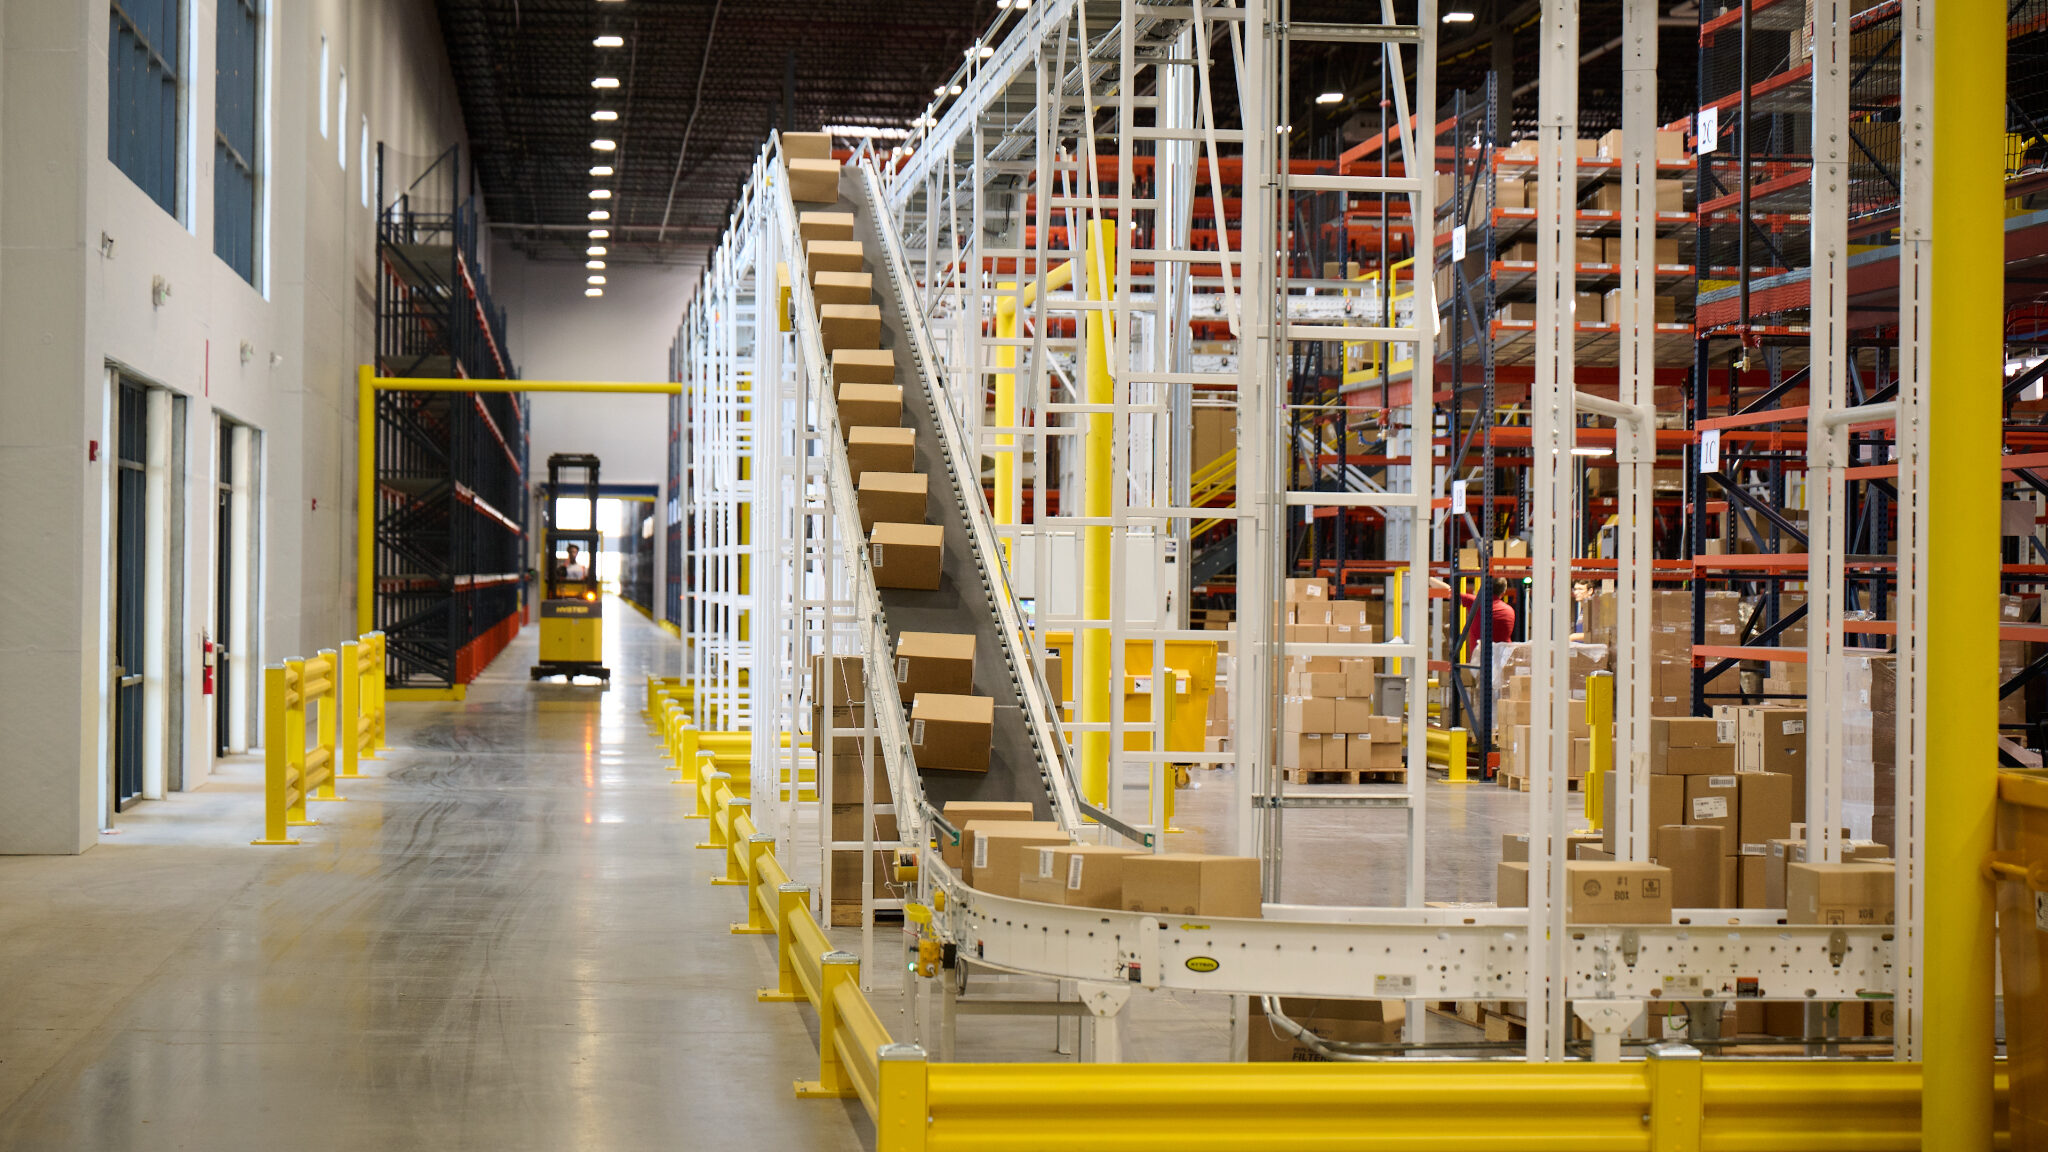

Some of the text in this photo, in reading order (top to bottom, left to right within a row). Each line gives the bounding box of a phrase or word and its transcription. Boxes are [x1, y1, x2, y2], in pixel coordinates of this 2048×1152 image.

[1702, 119, 1714, 145] 2C
[1704, 439, 1716, 464] 1C
[1614, 890, 1629, 901] BOX
